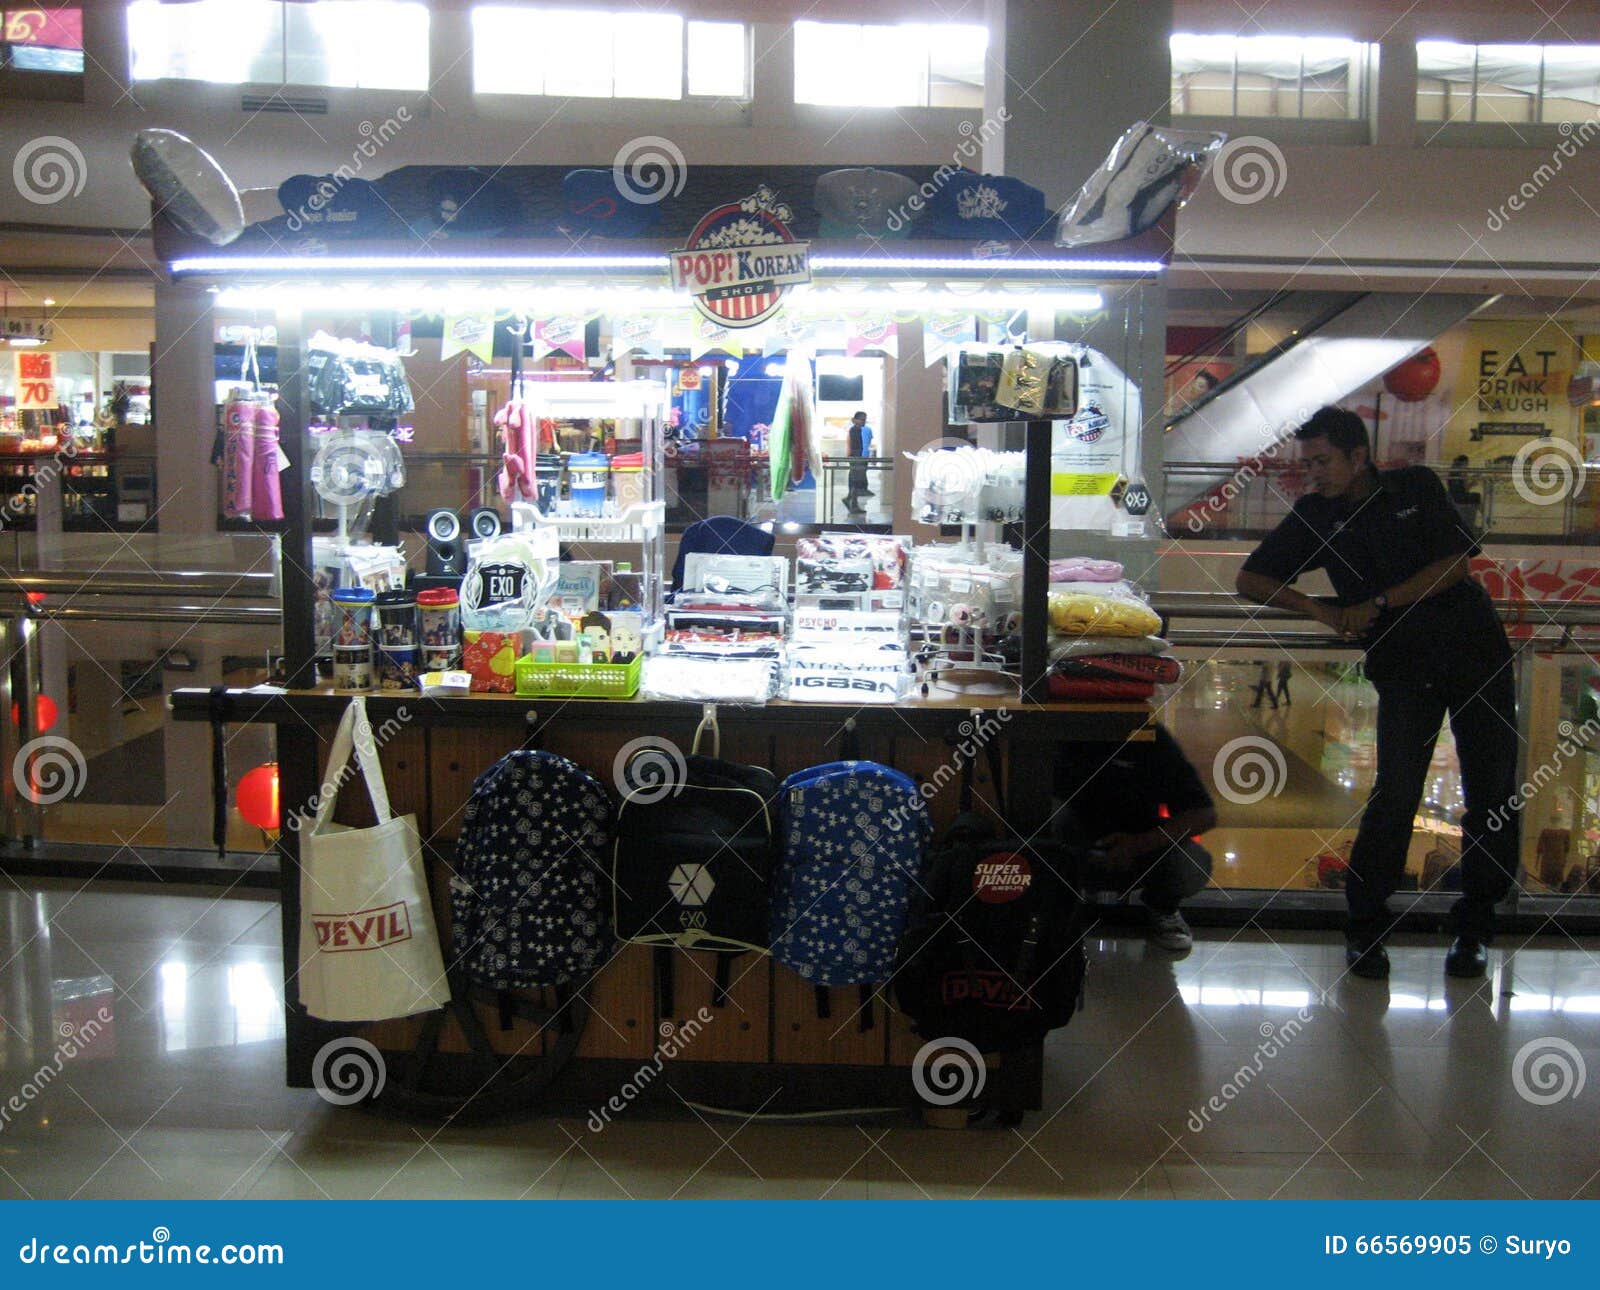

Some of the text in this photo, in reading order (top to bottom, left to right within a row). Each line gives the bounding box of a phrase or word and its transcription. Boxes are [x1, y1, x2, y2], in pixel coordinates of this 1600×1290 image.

[677, 252, 734, 287] POP!
[721, 285, 765, 297] SHOP
[1481, 350, 1557, 377] EAT
[20, 382, 49, 404] 70
[1479, 379, 1546, 395] DRINK
[1478, 398, 1549, 412] LAUGH
[489, 576, 515, 598] EXO
[798, 616, 838, 628] PSYCHO
[974, 864, 1021, 875] SUPER
[977, 874, 1031, 889] JUNIOR
[313, 911, 404, 946] DEVIL
[679, 911, 708, 929] EXO
